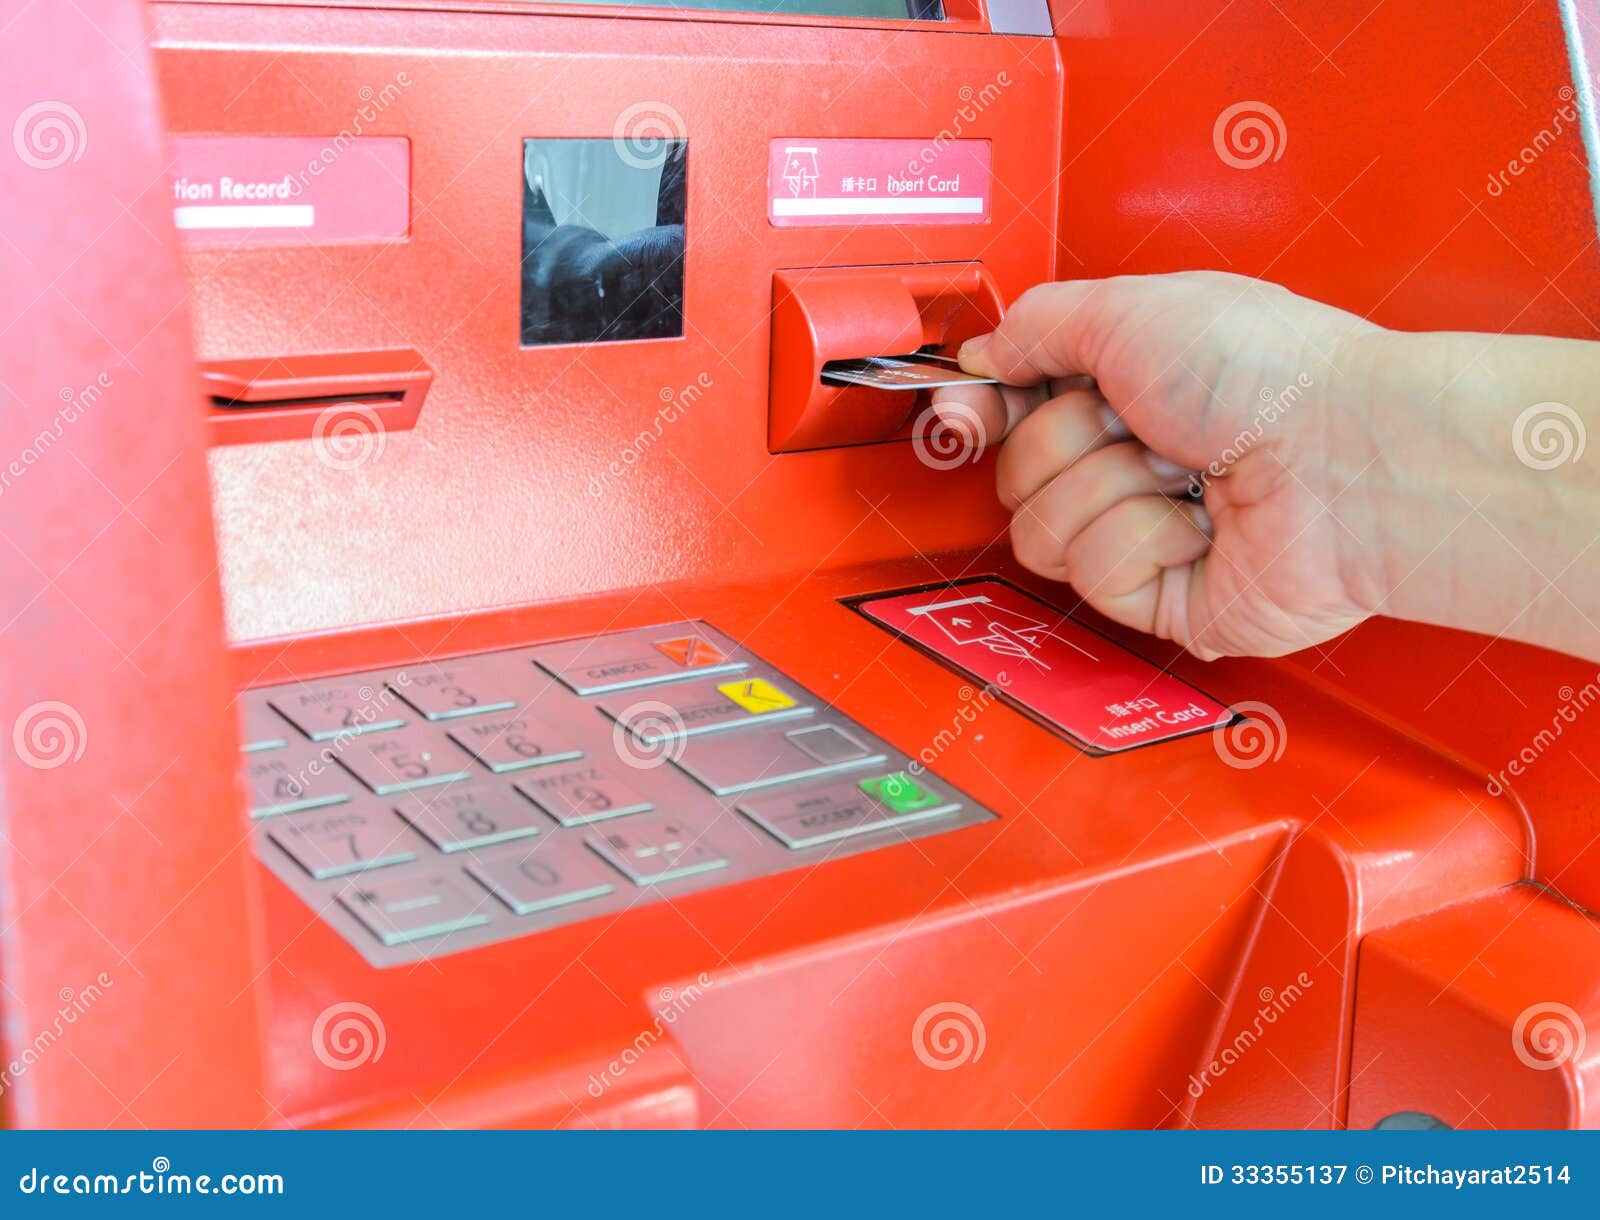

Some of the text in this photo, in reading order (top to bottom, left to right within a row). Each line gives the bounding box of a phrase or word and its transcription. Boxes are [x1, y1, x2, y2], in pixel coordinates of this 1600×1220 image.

[219, 175, 289, 199] Record
[888, 174, 960, 192] Insert Card
[1099, 702, 1209, 739] Insert Card
[505, 734, 542, 758] 6
[391, 752, 430, 779] 5
[572, 784, 613, 811] 9
[455, 807, 499, 836] 8
